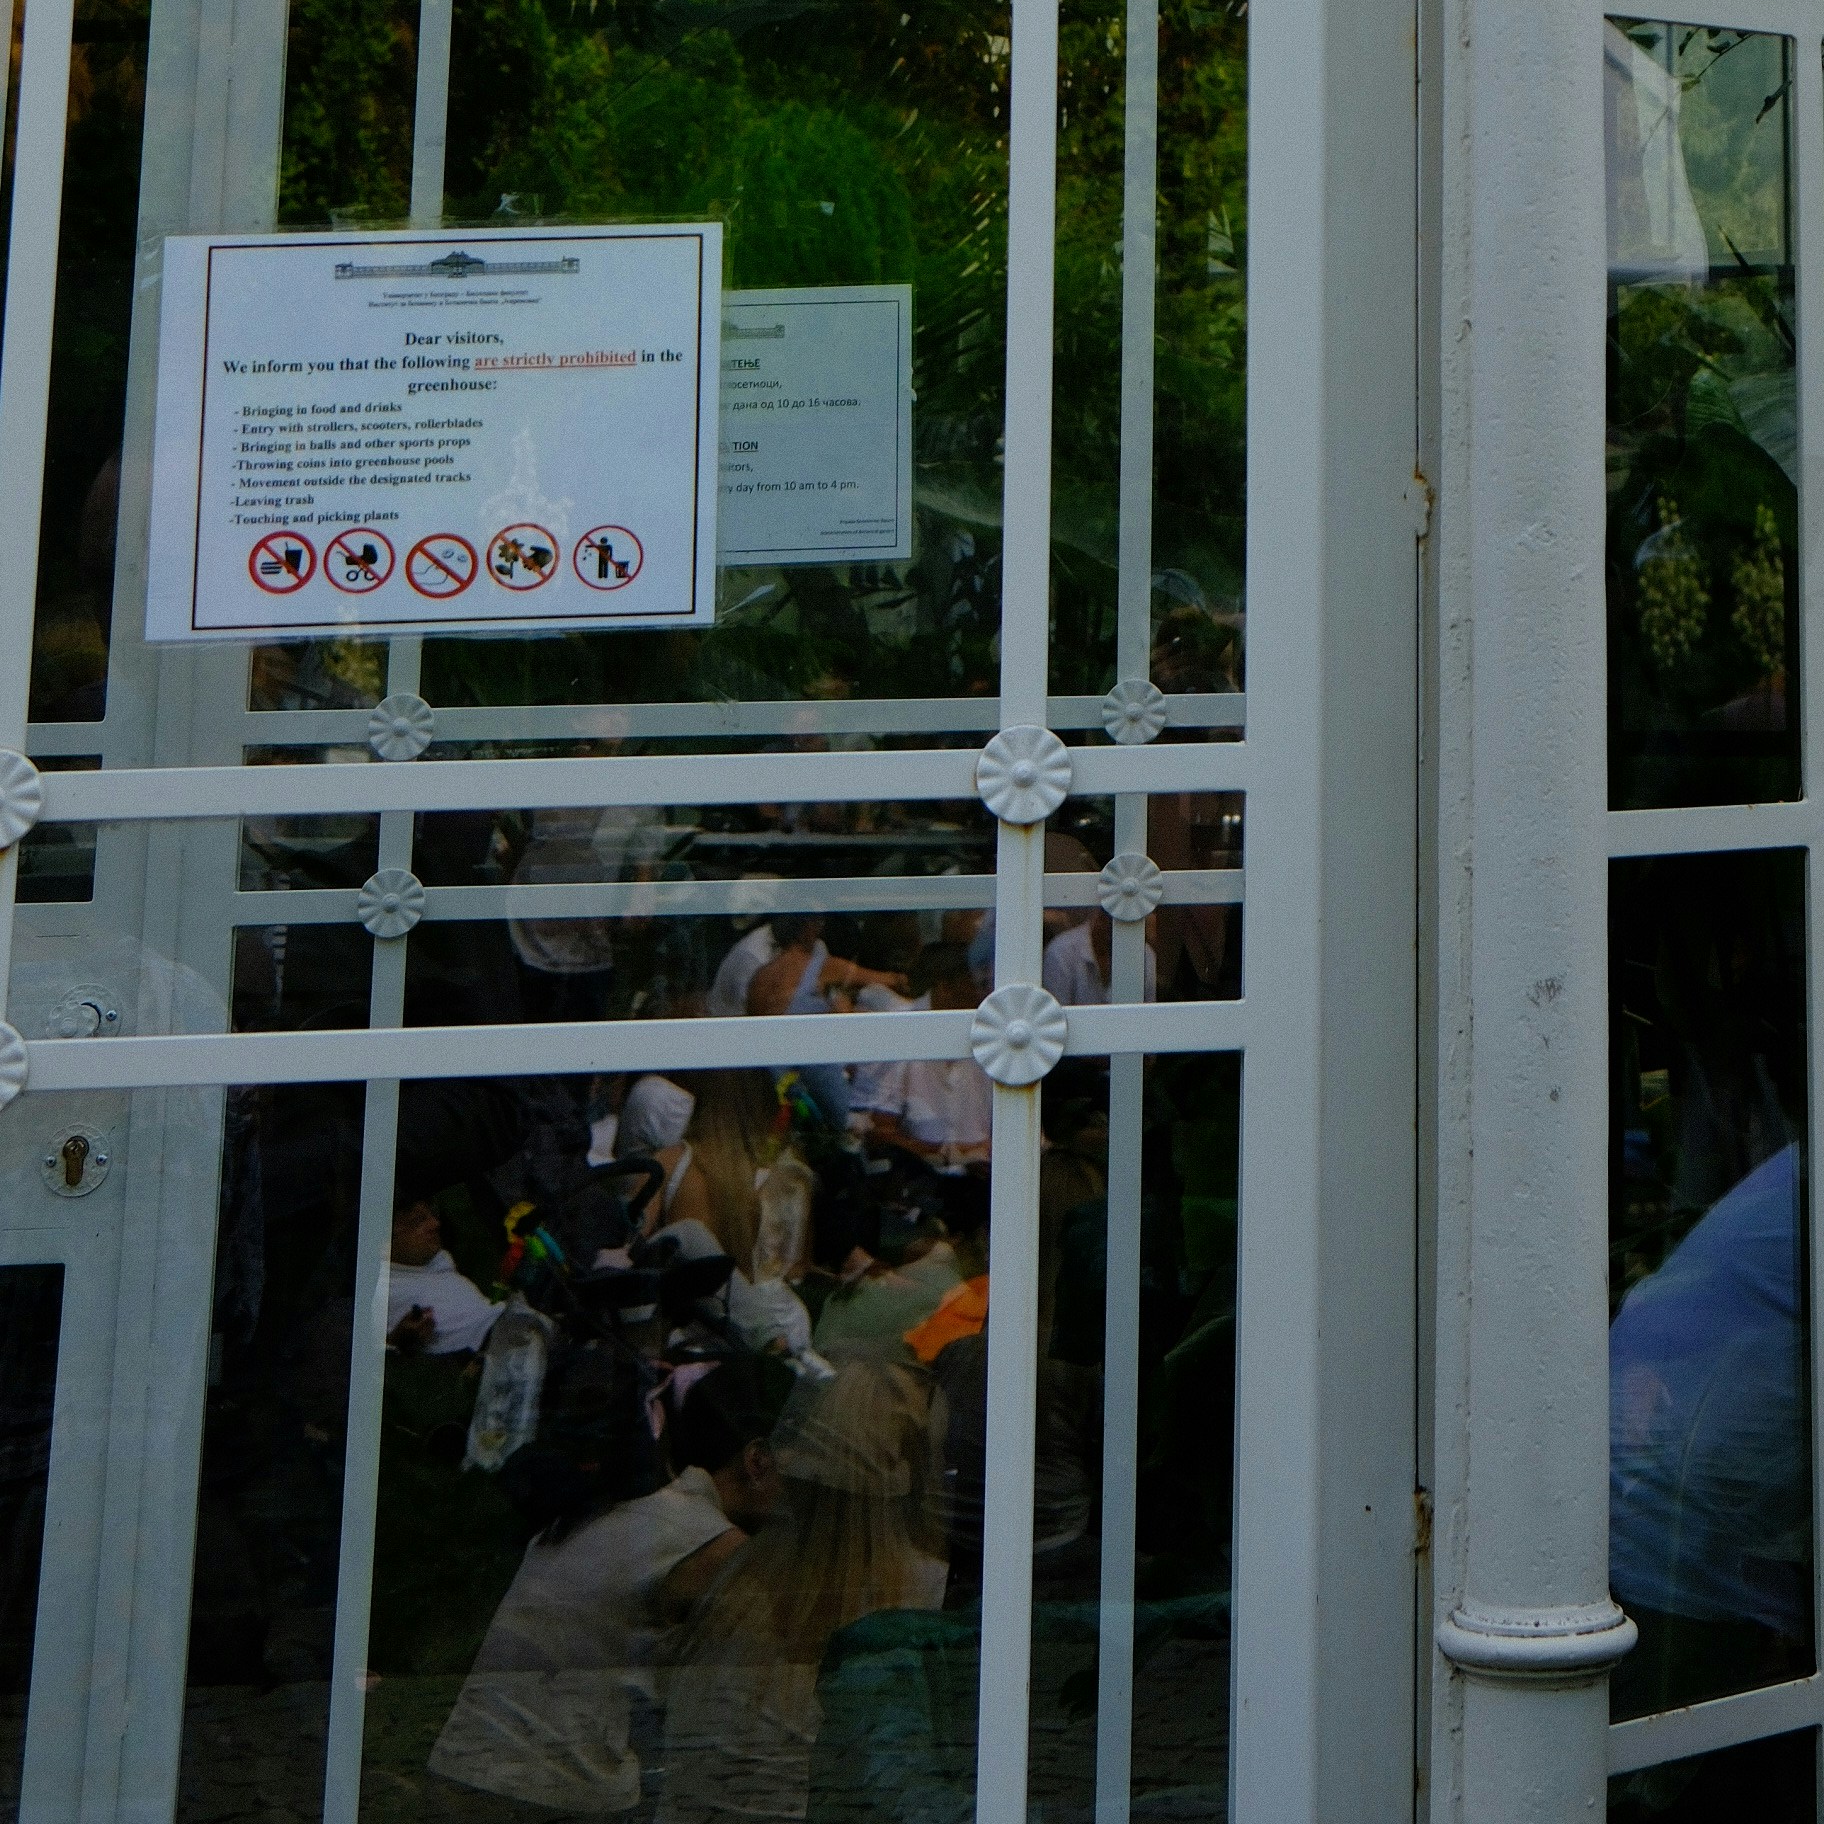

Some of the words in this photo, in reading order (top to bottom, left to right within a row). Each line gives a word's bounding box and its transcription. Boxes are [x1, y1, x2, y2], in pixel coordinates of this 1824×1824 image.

[405, 332, 442, 346] Dear
[447, 330, 504, 346] visitors,
[223, 360, 248, 373] We
[252, 359, 302, 373] inform
[307, 360, 334, 374] you
[340, 358, 369, 371] that
[374, 356, 397, 370] the
[402, 354, 471, 370] following
[475, 356, 500, 367] are
[502, 353, 553, 368] strictly
[559, 350, 637, 368] prohibited
[641, 350, 655, 363] in
[660, 349, 683, 362] the
[408, 379, 498, 395] greenhouse:
[243, 406, 293, 417] Bringing
[298, 404, 307, 415] in
[311, 404, 336, 414] food
[340, 404, 361, 413] and
[365, 402, 402, 413] drinks
[733, 401, 758, 411] дана
[761, 400, 774, 410] од
[778, 399, 789, 408] 10
[792, 399, 805, 409] до
[809, 398, 820, 407] 16
[242, 424, 274, 435] Entry
[279, 423, 303, 433] with
[307, 422, 358, 433] strollers,
[361, 421, 411, 432] scooters,
[415, 418, 483, 429] rollerblades
[241, 441, 291, 453] Bringing
[296, 441, 307, 451] in
[310, 440, 336, 450] balls
[340, 439, 361, 449] and
[365, 438, 397, 449] other
[399, 438, 434, 450] sports
[438, 437, 471, 448] props
[297, 458, 326, 468] coins
[330, 457, 352, 467] into
[355, 456, 421, 469] greenhouse
[425, 455, 454, 466] pools
[239, 478, 300, 488] Movement
[304, 475, 345, 486] outside
[349, 474, 367, 485] the
[370, 473, 431, 486] designated
[435, 472, 471, 483] tracks
[736, 482, 754, 493] day
[757, 481, 781, 491] from
[785, 481, 796, 491] 10
[799, 482, 814, 490] am
[818, 481, 828, 489] to
[840, 481, 859, 491] pm.
[285, 495, 314, 505] trash
[293, 513, 314, 523] and
[317, 511, 360, 525] picking
[364, 510, 399, 522] plants
